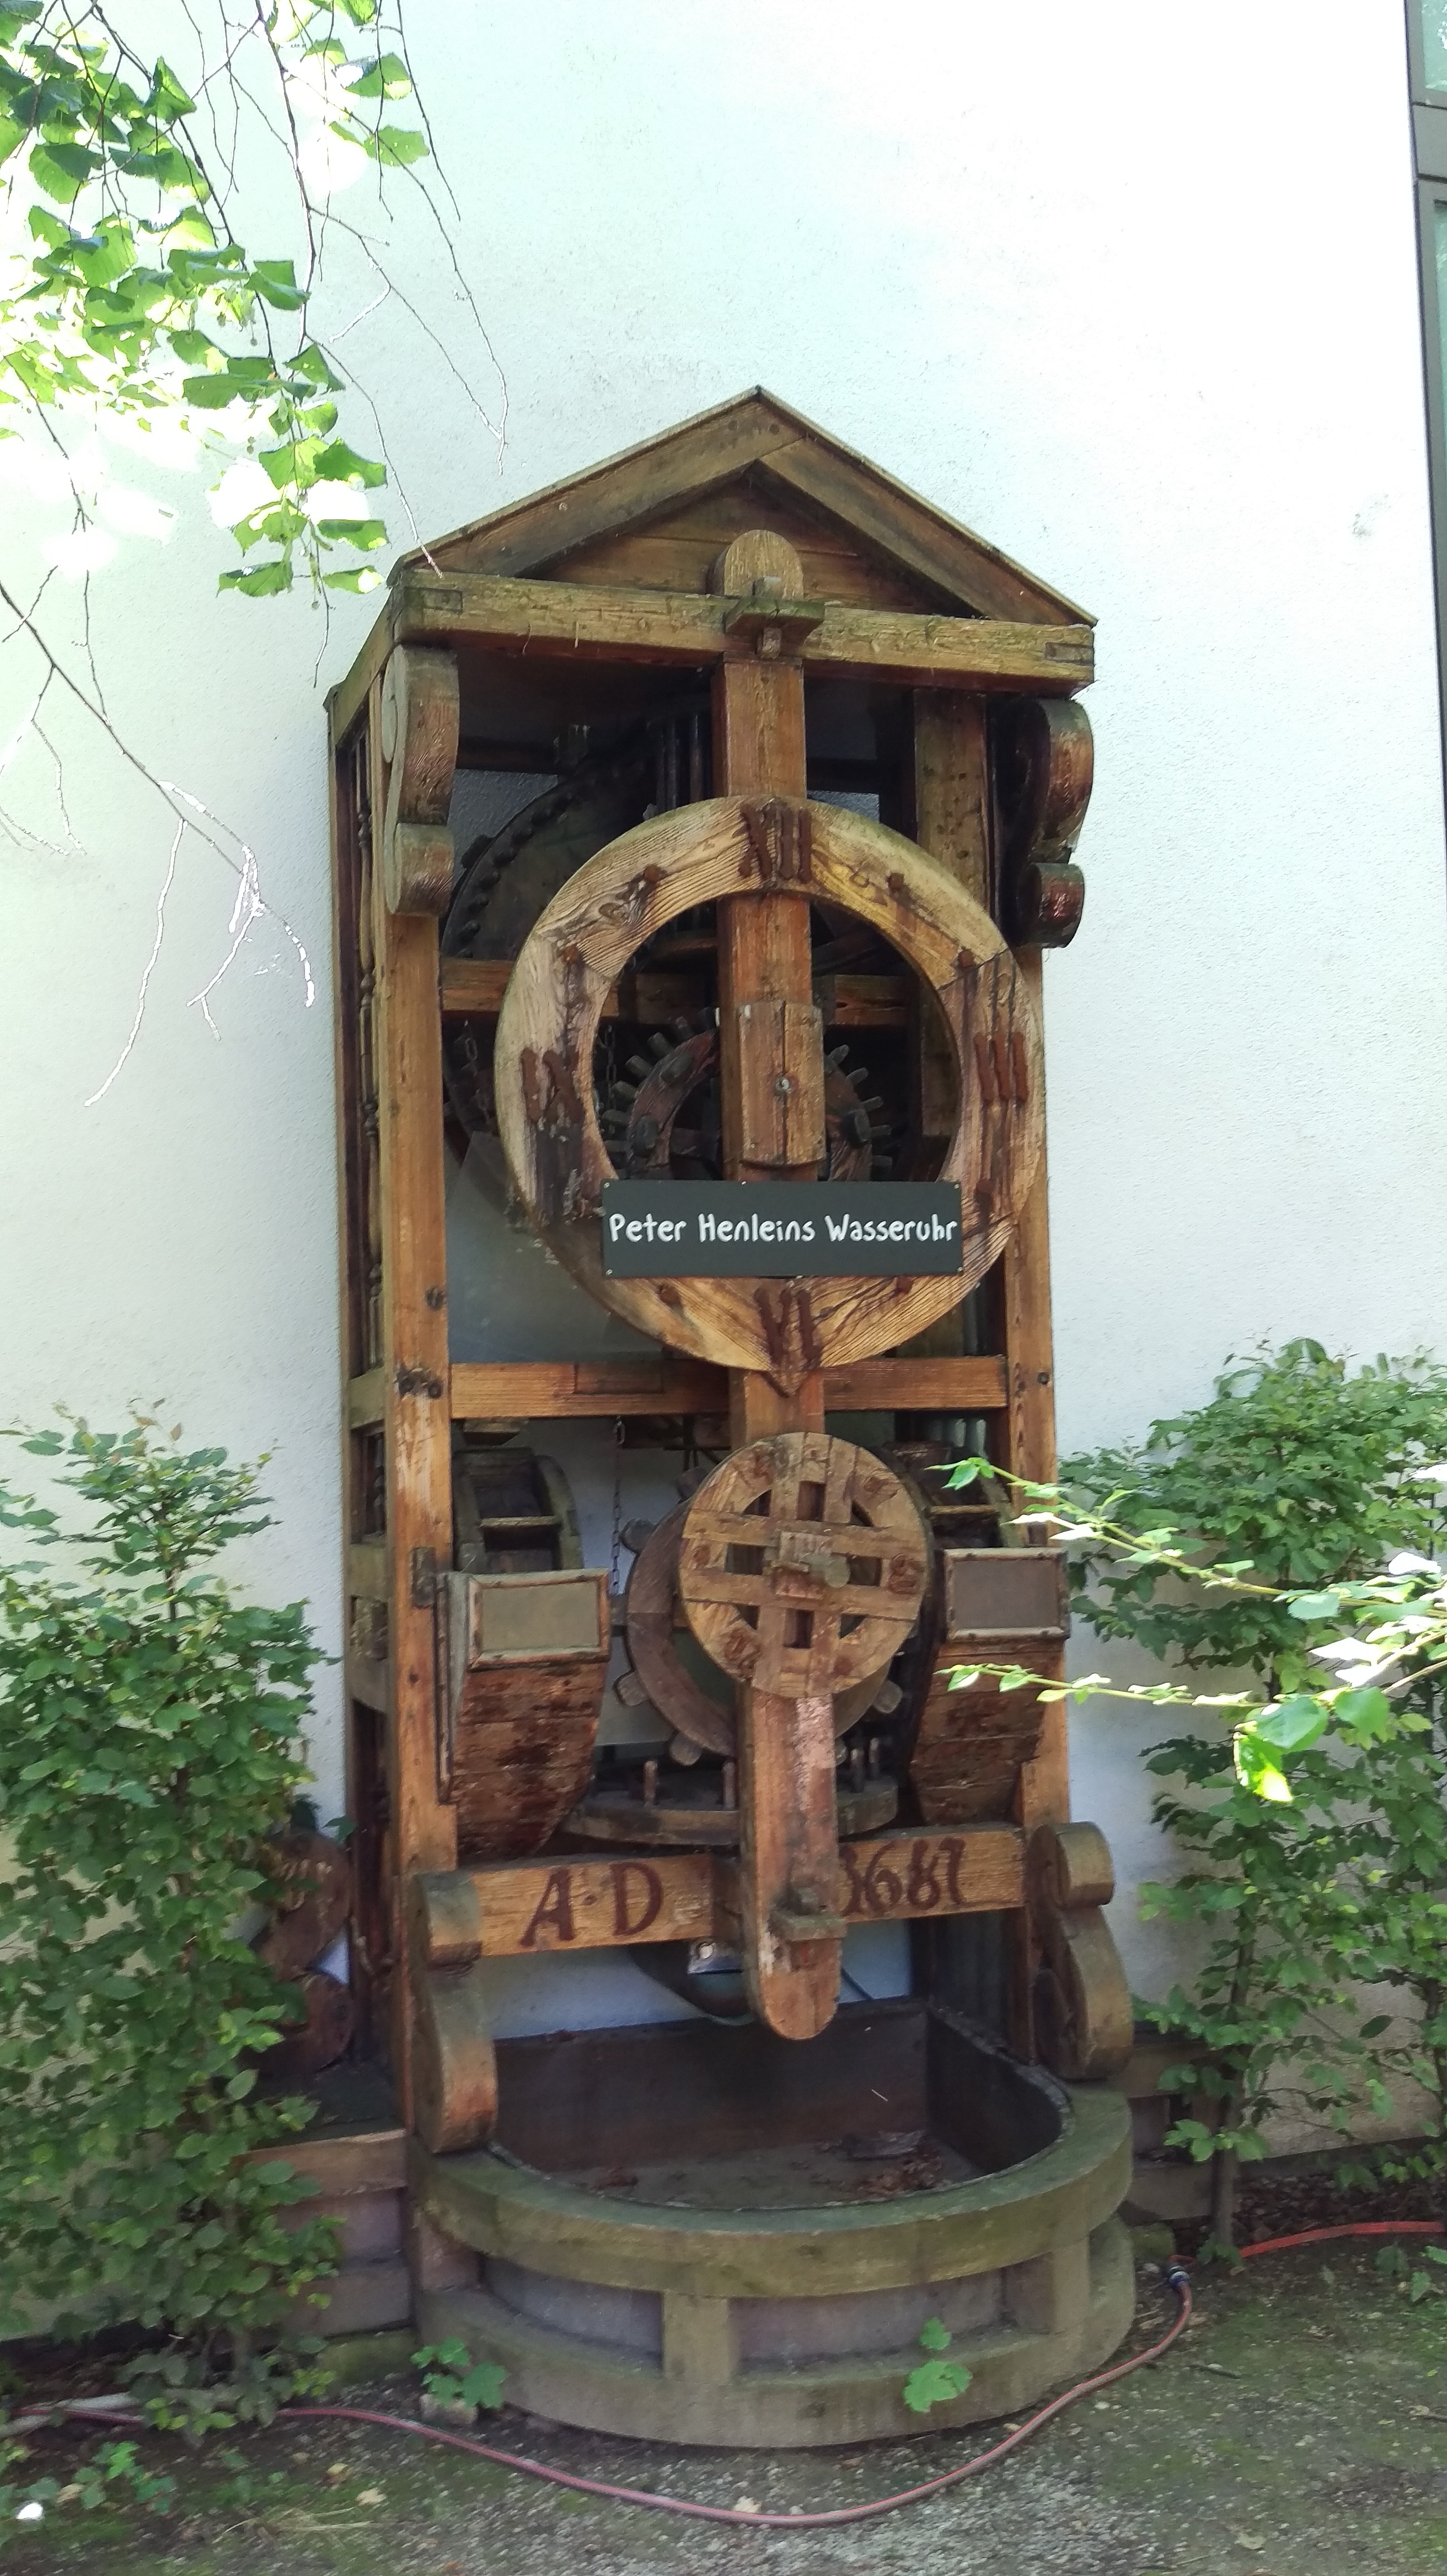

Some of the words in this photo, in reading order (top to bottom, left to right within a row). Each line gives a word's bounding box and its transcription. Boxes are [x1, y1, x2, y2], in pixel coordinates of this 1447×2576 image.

[738, 803, 812, 883] XII
[609, 1213, 687, 1242] Peter
[698, 1213, 816, 1242] Henleins
[825, 1213, 957, 1242] Wasseruhr
